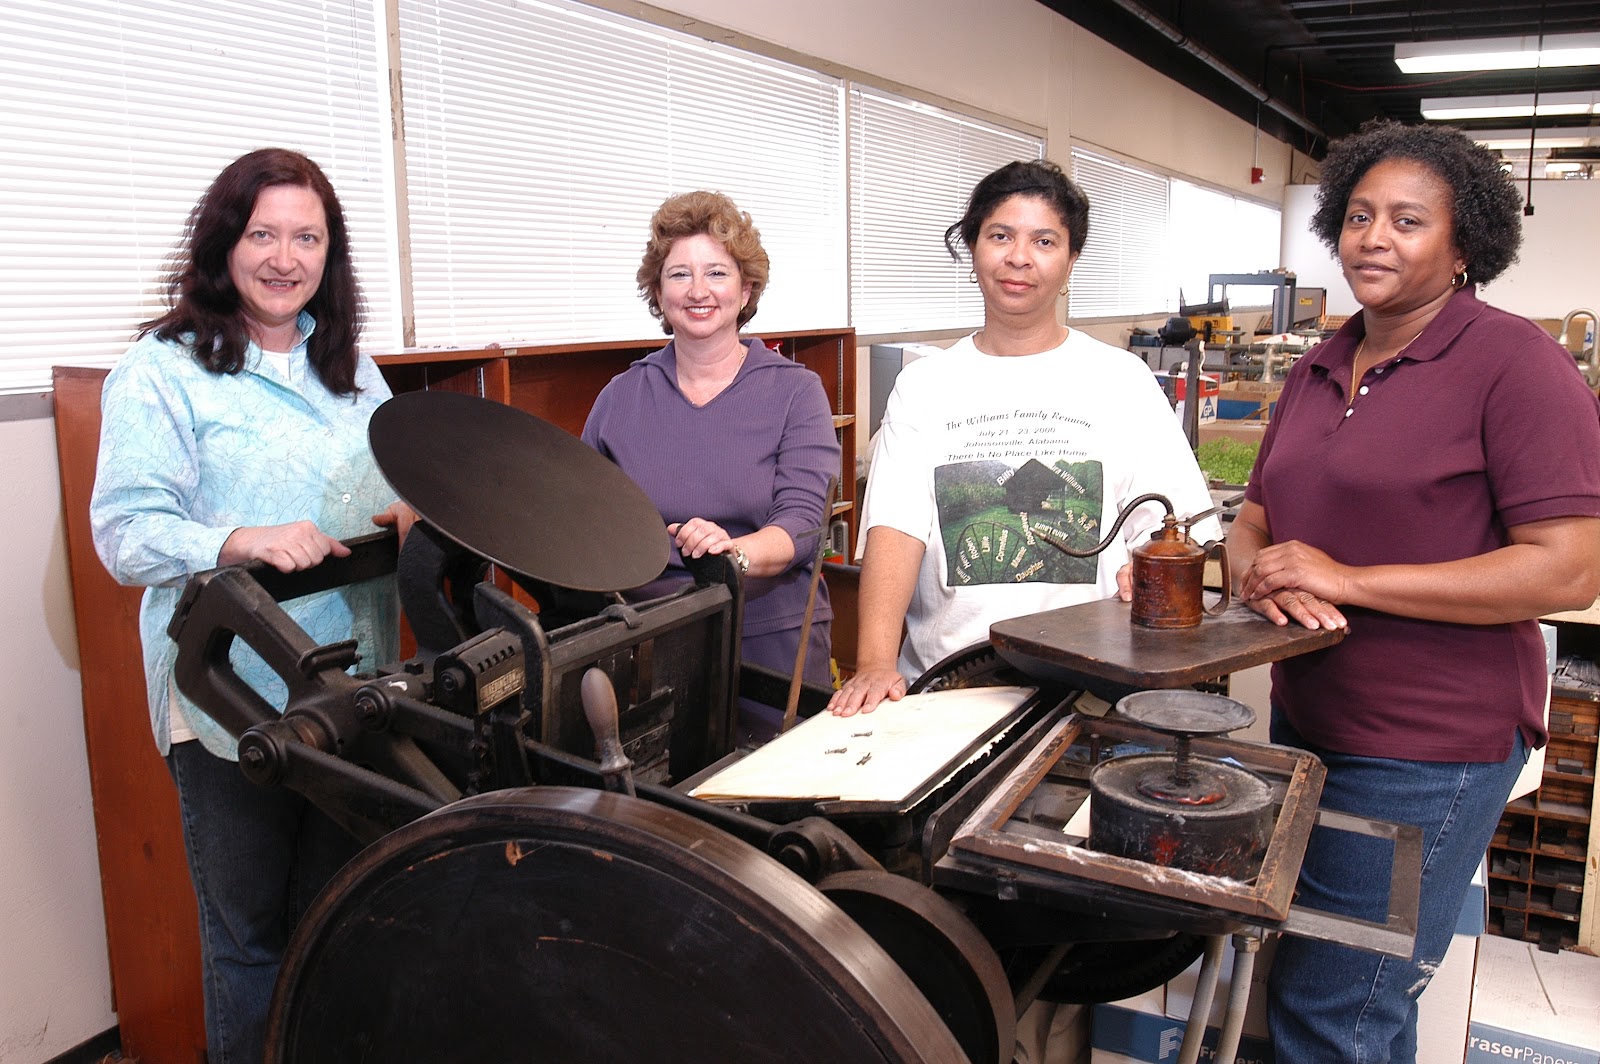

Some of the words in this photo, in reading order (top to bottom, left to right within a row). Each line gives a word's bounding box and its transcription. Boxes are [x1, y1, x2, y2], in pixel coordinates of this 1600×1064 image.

[945, 421, 962, 431] The
[966, 413, 1009, 426] Williams
[1014, 409, 1048, 421] Family
[1051, 411, 1092, 428] Reunion
[1203, 404, 1213, 417] GP
[976, 430, 996, 438] July
[1033, 427, 1056, 435] 2000
[948, 453, 974, 461] There
[976, 451, 985, 459] Is
[988, 450, 1002, 458] No
[1034, 448, 1056, 457] Like
[1058, 448, 1088, 457] Home
[996, 467, 1016, 486] Billy
[1060, 469, 1086, 494] Williams
[1052, 529, 1069, 541] Anna
[965, 537, 980, 560] Robert
[1014, 560, 1045, 582] Daughter
